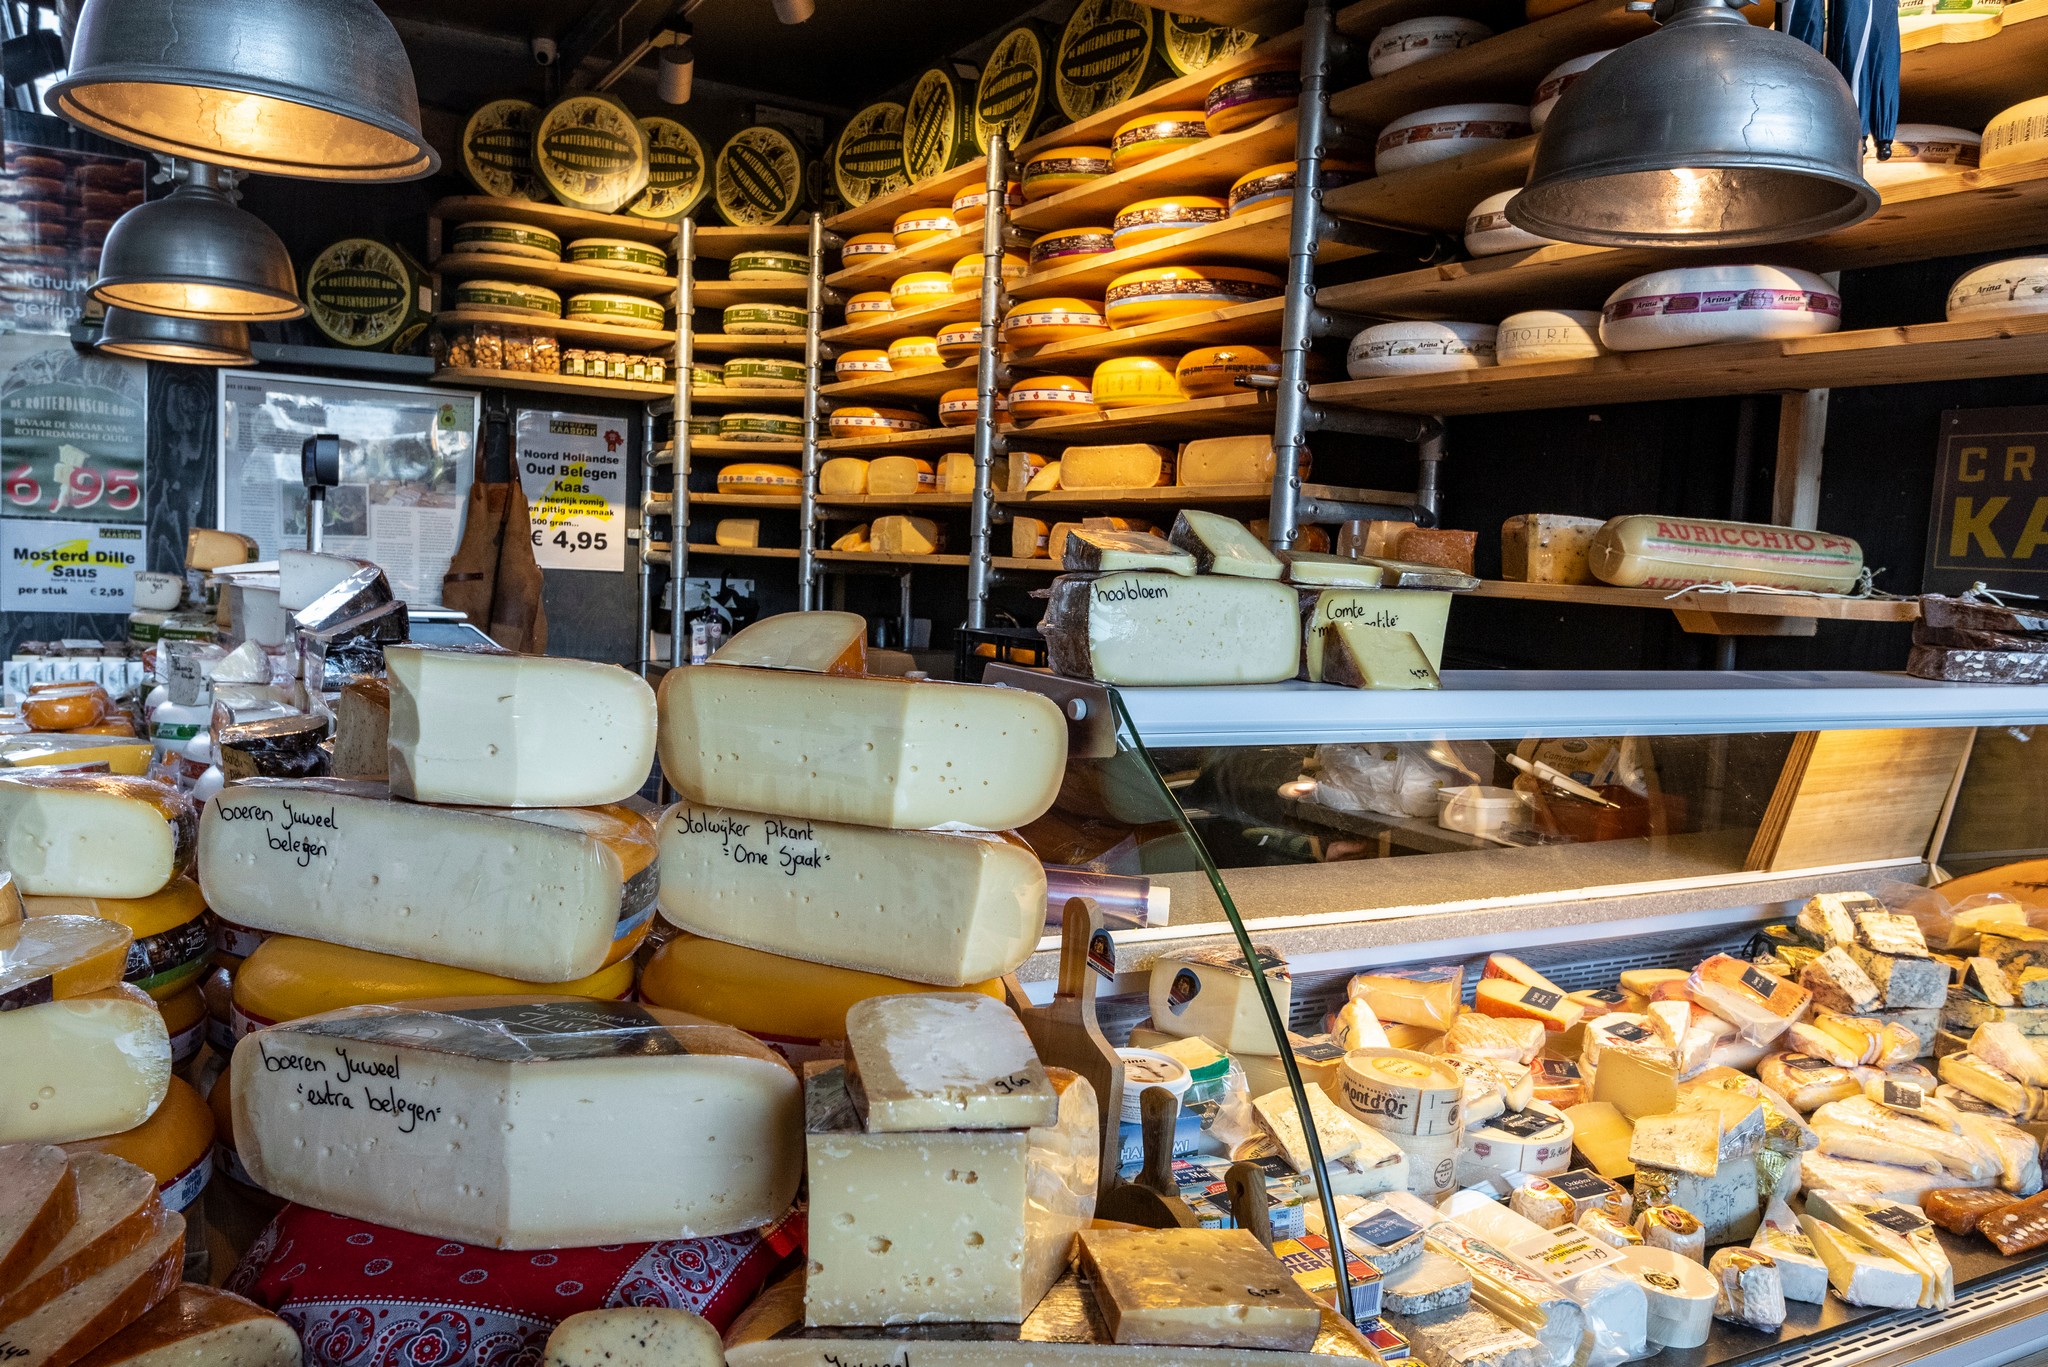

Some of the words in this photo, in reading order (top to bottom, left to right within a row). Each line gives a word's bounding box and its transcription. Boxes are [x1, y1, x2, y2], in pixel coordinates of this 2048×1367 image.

[1923, 144, 1949, 154] Arina
[1976, 282, 2002, 295] Arina
[1704, 296, 1731, 305] Arina
[1777, 294, 1801, 302] Arina
[14, 296, 82, 321] gerijpt
[26, 396, 109, 415] ROTTERDAMSCHE
[15, 418, 52, 428] ERVAAR
[70, 422, 103, 431] SMAAK
[107, 425, 125, 433] VAN
[550, 425, 596, 436] KAASDOK
[15, 428, 99, 439] ROTTERDAMSCHE
[524, 449, 559, 460] Noord
[563, 452, 619, 464] Hollandse
[526, 463, 555, 475] Oud
[560, 466, 617, 479] Belegen
[6, 464, 140, 513] 6,95
[554, 481, 590, 493] Kaas
[545, 496, 577, 505] heerlijk
[579, 499, 604, 507] romig
[542, 506, 566, 515] pittig
[532, 530, 543, 546] €
[553, 530, 608, 552] 4,95
[1657, 522, 1815, 551] AURICCHIO
[14, 548, 89, 562] Mosterd
[96, 551, 135, 564] Dille
[53, 565, 97, 578] Saus
[18, 587, 38, 595] per
[42, 586, 67, 595] stuk
[100, 588, 124, 597] 2,95
[1094, 578, 1169, 602] hooibloem
[216, 798, 273, 821] boeren
[281, 800, 338, 830] Juweel
[267, 828, 327, 867] belegen
[259, 1041, 327, 1072] boeren
[335, 1047, 401, 1083] Juweel
[1343, 1081, 1370, 1106] Mont
[1371, 1095, 1408, 1115] d'Or
